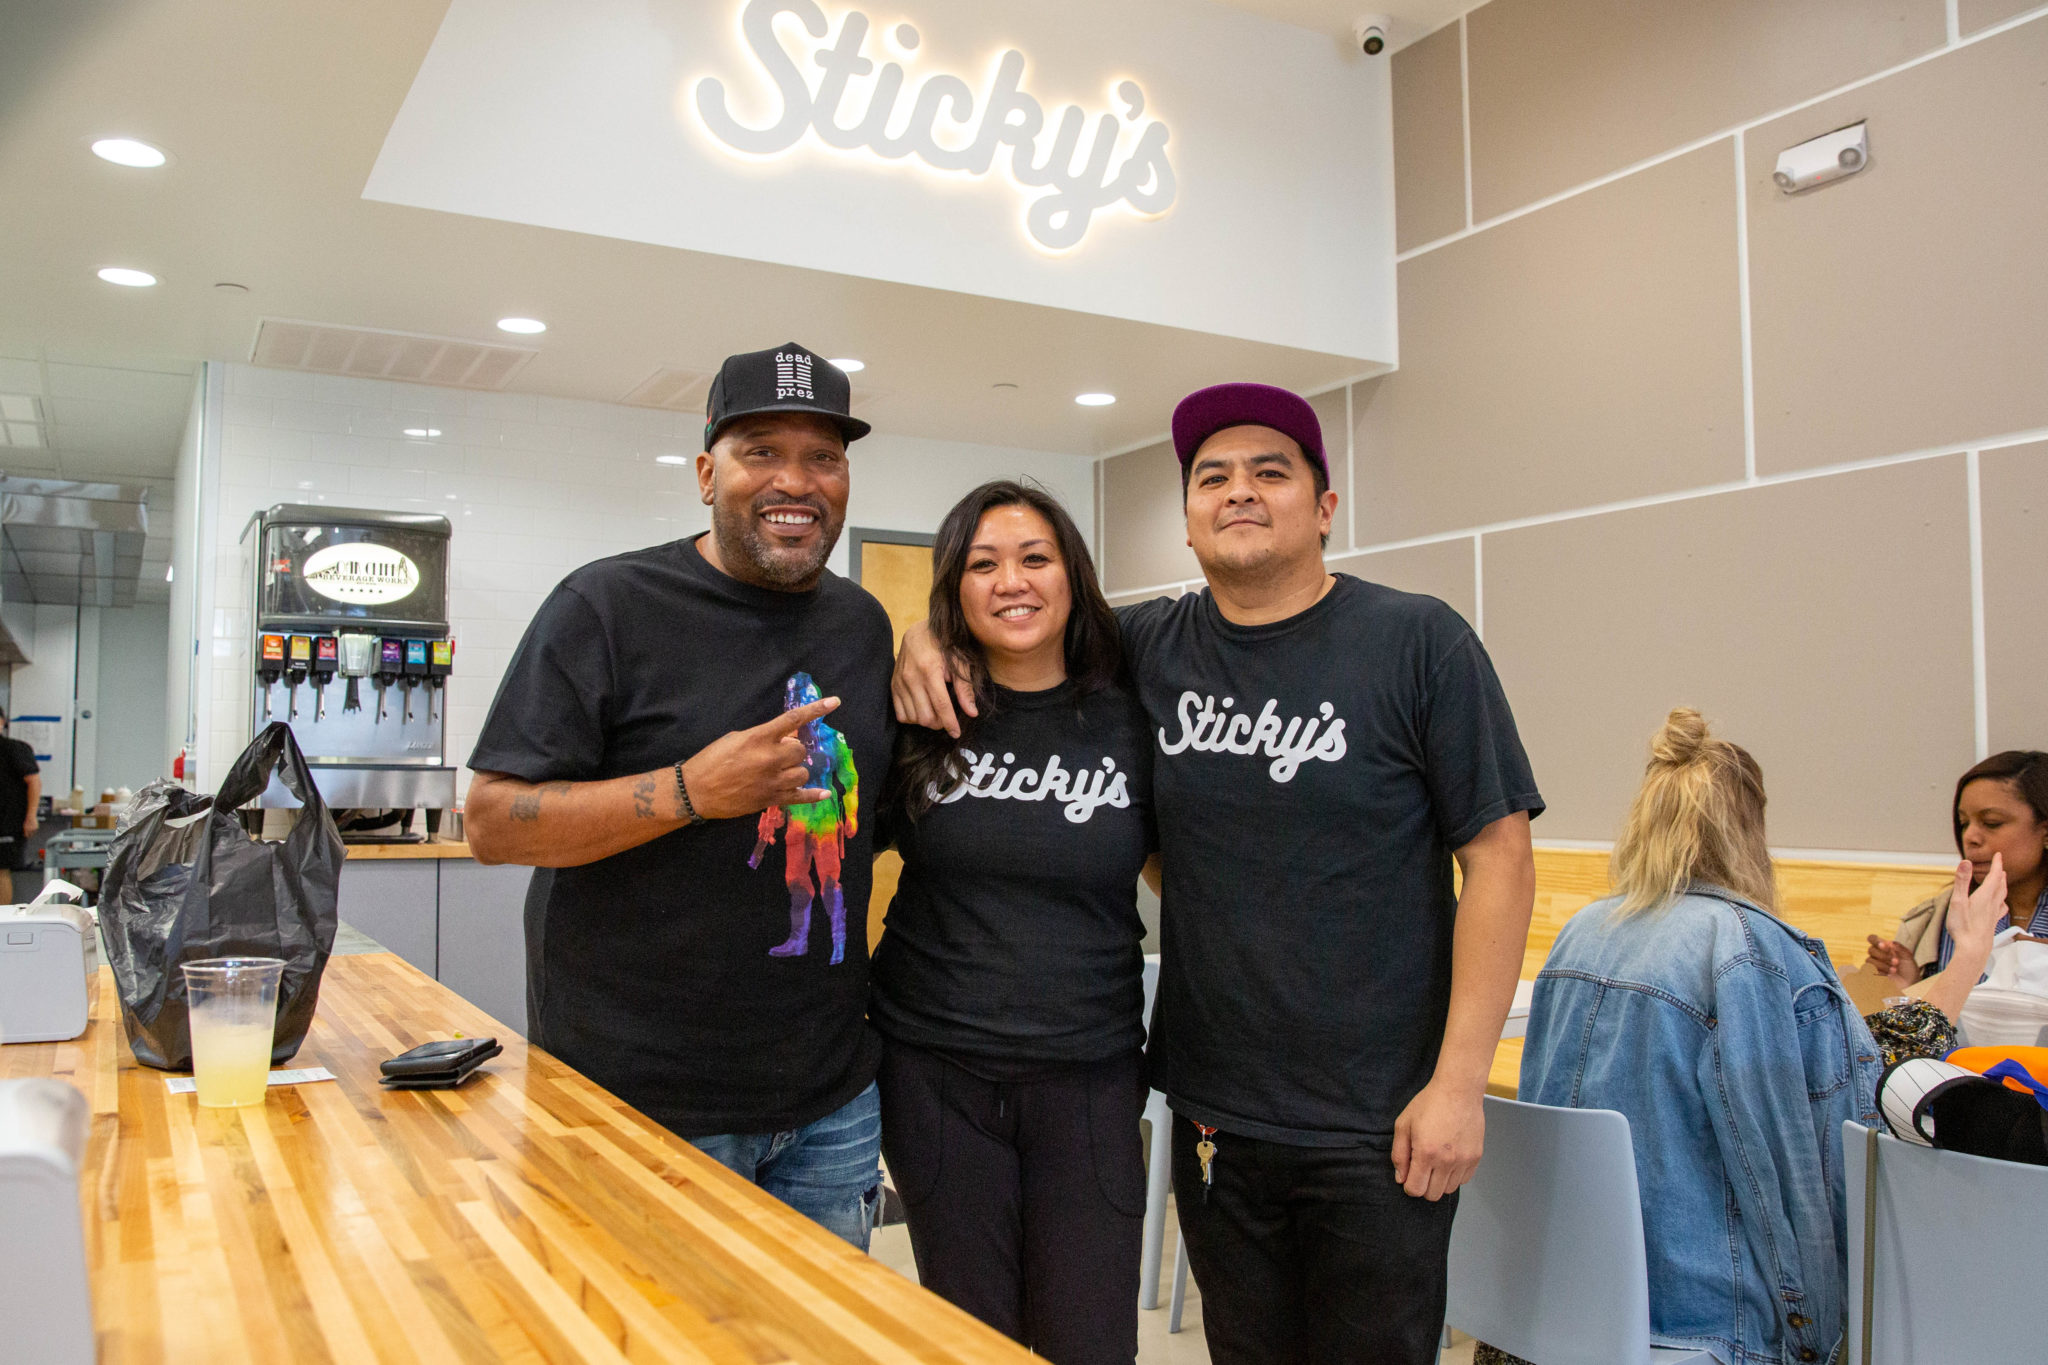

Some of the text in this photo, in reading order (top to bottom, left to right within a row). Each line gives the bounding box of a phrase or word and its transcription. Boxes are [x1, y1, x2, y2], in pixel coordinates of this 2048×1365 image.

[696, 0, 1177, 250] Sticky's
[775, 352, 813, 366] dead
[776, 388, 814, 400] prez
[1159, 691, 1347, 783] Sticky's
[926, 748, 1130, 823] Sticky's
